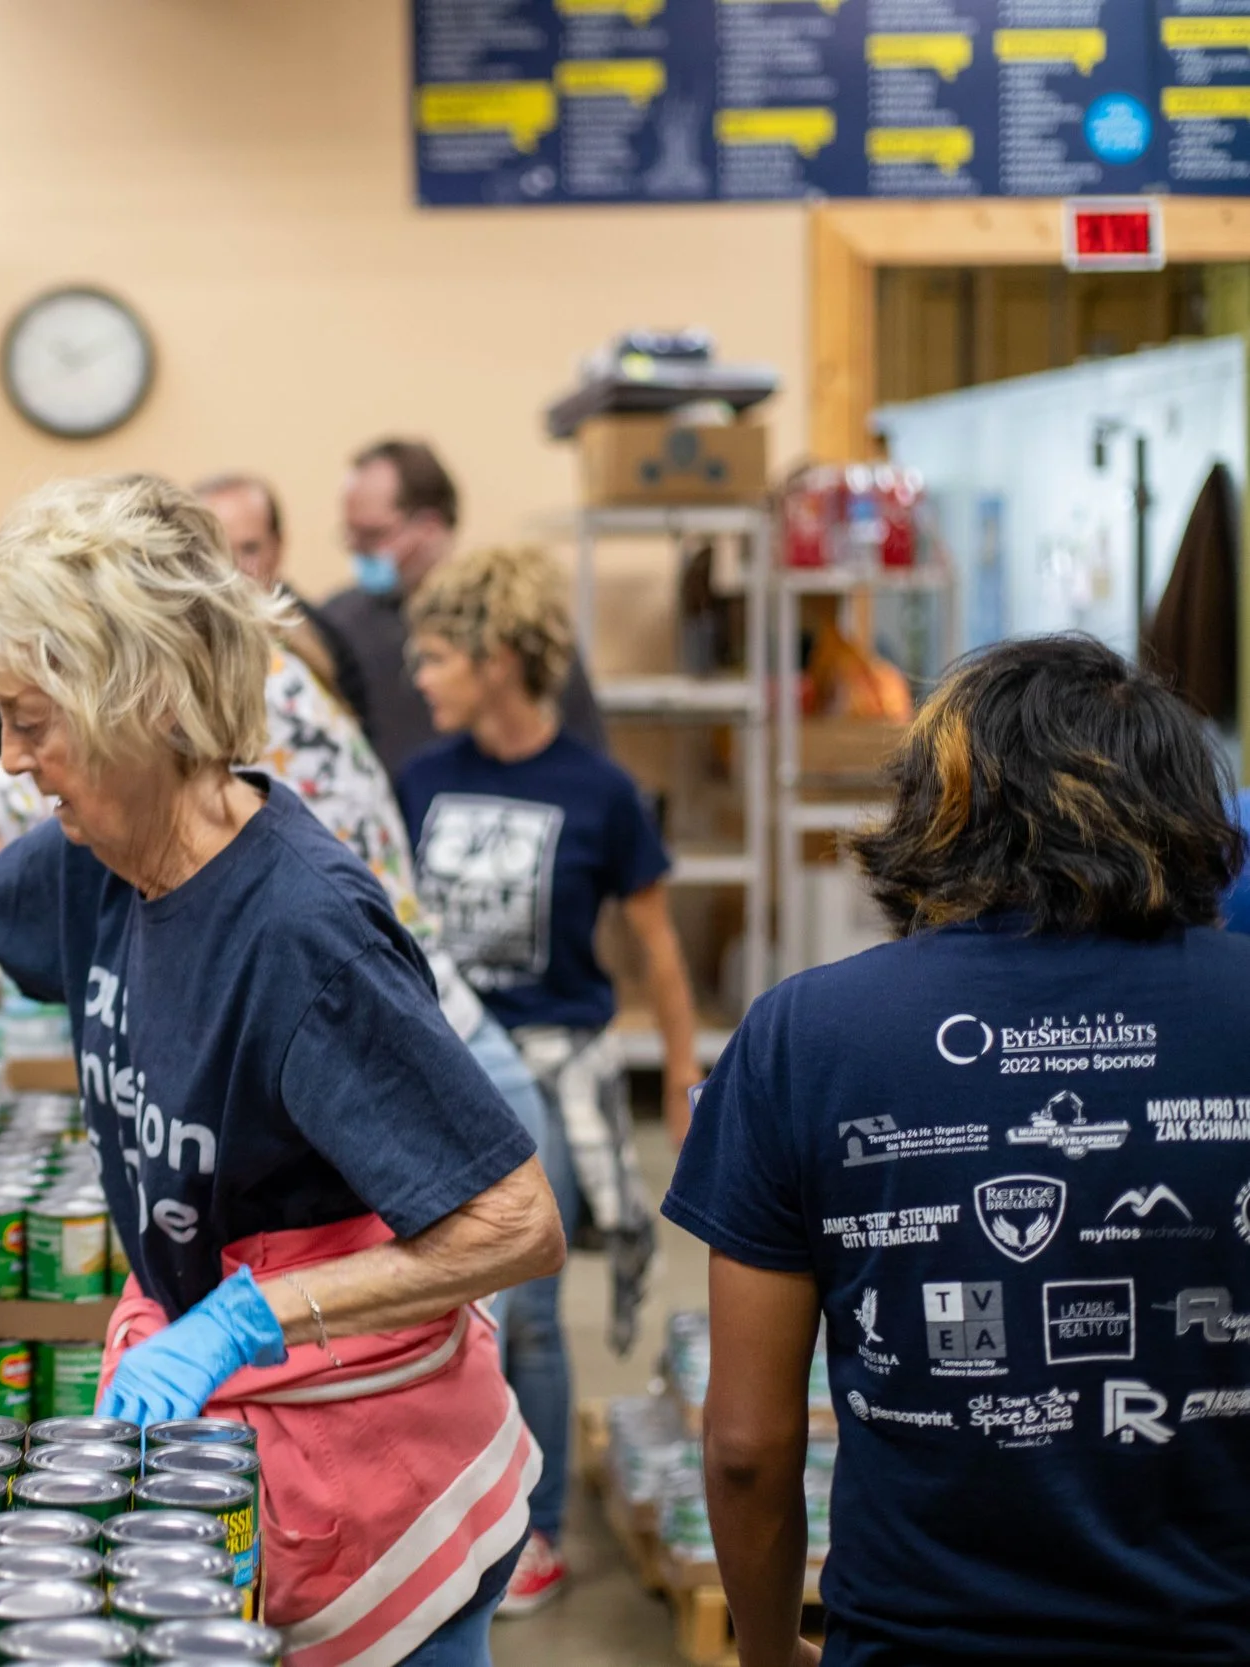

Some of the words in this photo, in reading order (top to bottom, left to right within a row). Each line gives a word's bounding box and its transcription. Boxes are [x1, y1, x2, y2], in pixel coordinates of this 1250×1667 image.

[1030, 1012, 1124, 1027] INLAND
[1001, 1056, 1040, 1074] 2022
[1044, 1055, 1089, 1073] Hope
[1093, 1053, 1157, 1072] Sponsor
[1147, 1098, 1201, 1121] MAYOR
[1203, 1098, 1234, 1120] PRO
[906, 1128, 918, 1138] 24
[934, 1125, 966, 1136] Urgent
[966, 1123, 989, 1133] Care
[1052, 1134, 1119, 1146] DEVELOPMENT
[1155, 1120, 1187, 1141] ZAK
[900, 1137, 934, 1149] Marcos
[934, 1135, 966, 1147] Urgent
[967, 1133, 989, 1143] Care
[985, 1186, 1056, 1200] REFUGE
[986, 1197, 1056, 1211] BREWERY
[822, 1216, 858, 1234] JAMES
[899, 1205, 960, 1227] STEWART
[842, 1231, 866, 1249] CITY
[880, 1225, 939, 1247] EMECULA
[1079, 1226, 1141, 1244] mythos
[935, 1291, 951, 1313] T
[972, 1289, 993, 1312] V
[1060, 1301, 1115, 1319] LAZARUS
[939, 1330, 953, 1350] E
[975, 1328, 997, 1350] A
[1058, 1321, 1103, 1339] REALTY
[1107, 1320, 1124, 1336] CO
[968, 1395, 993, 1411] Old
[997, 1396, 1030, 1410] Town
[969, 1409, 1022, 1436] Spice
[1024, 1406, 1041, 1424] &
[1042, 1403, 1073, 1421] Tea
[1013, 1418, 1074, 1437] Merchants
